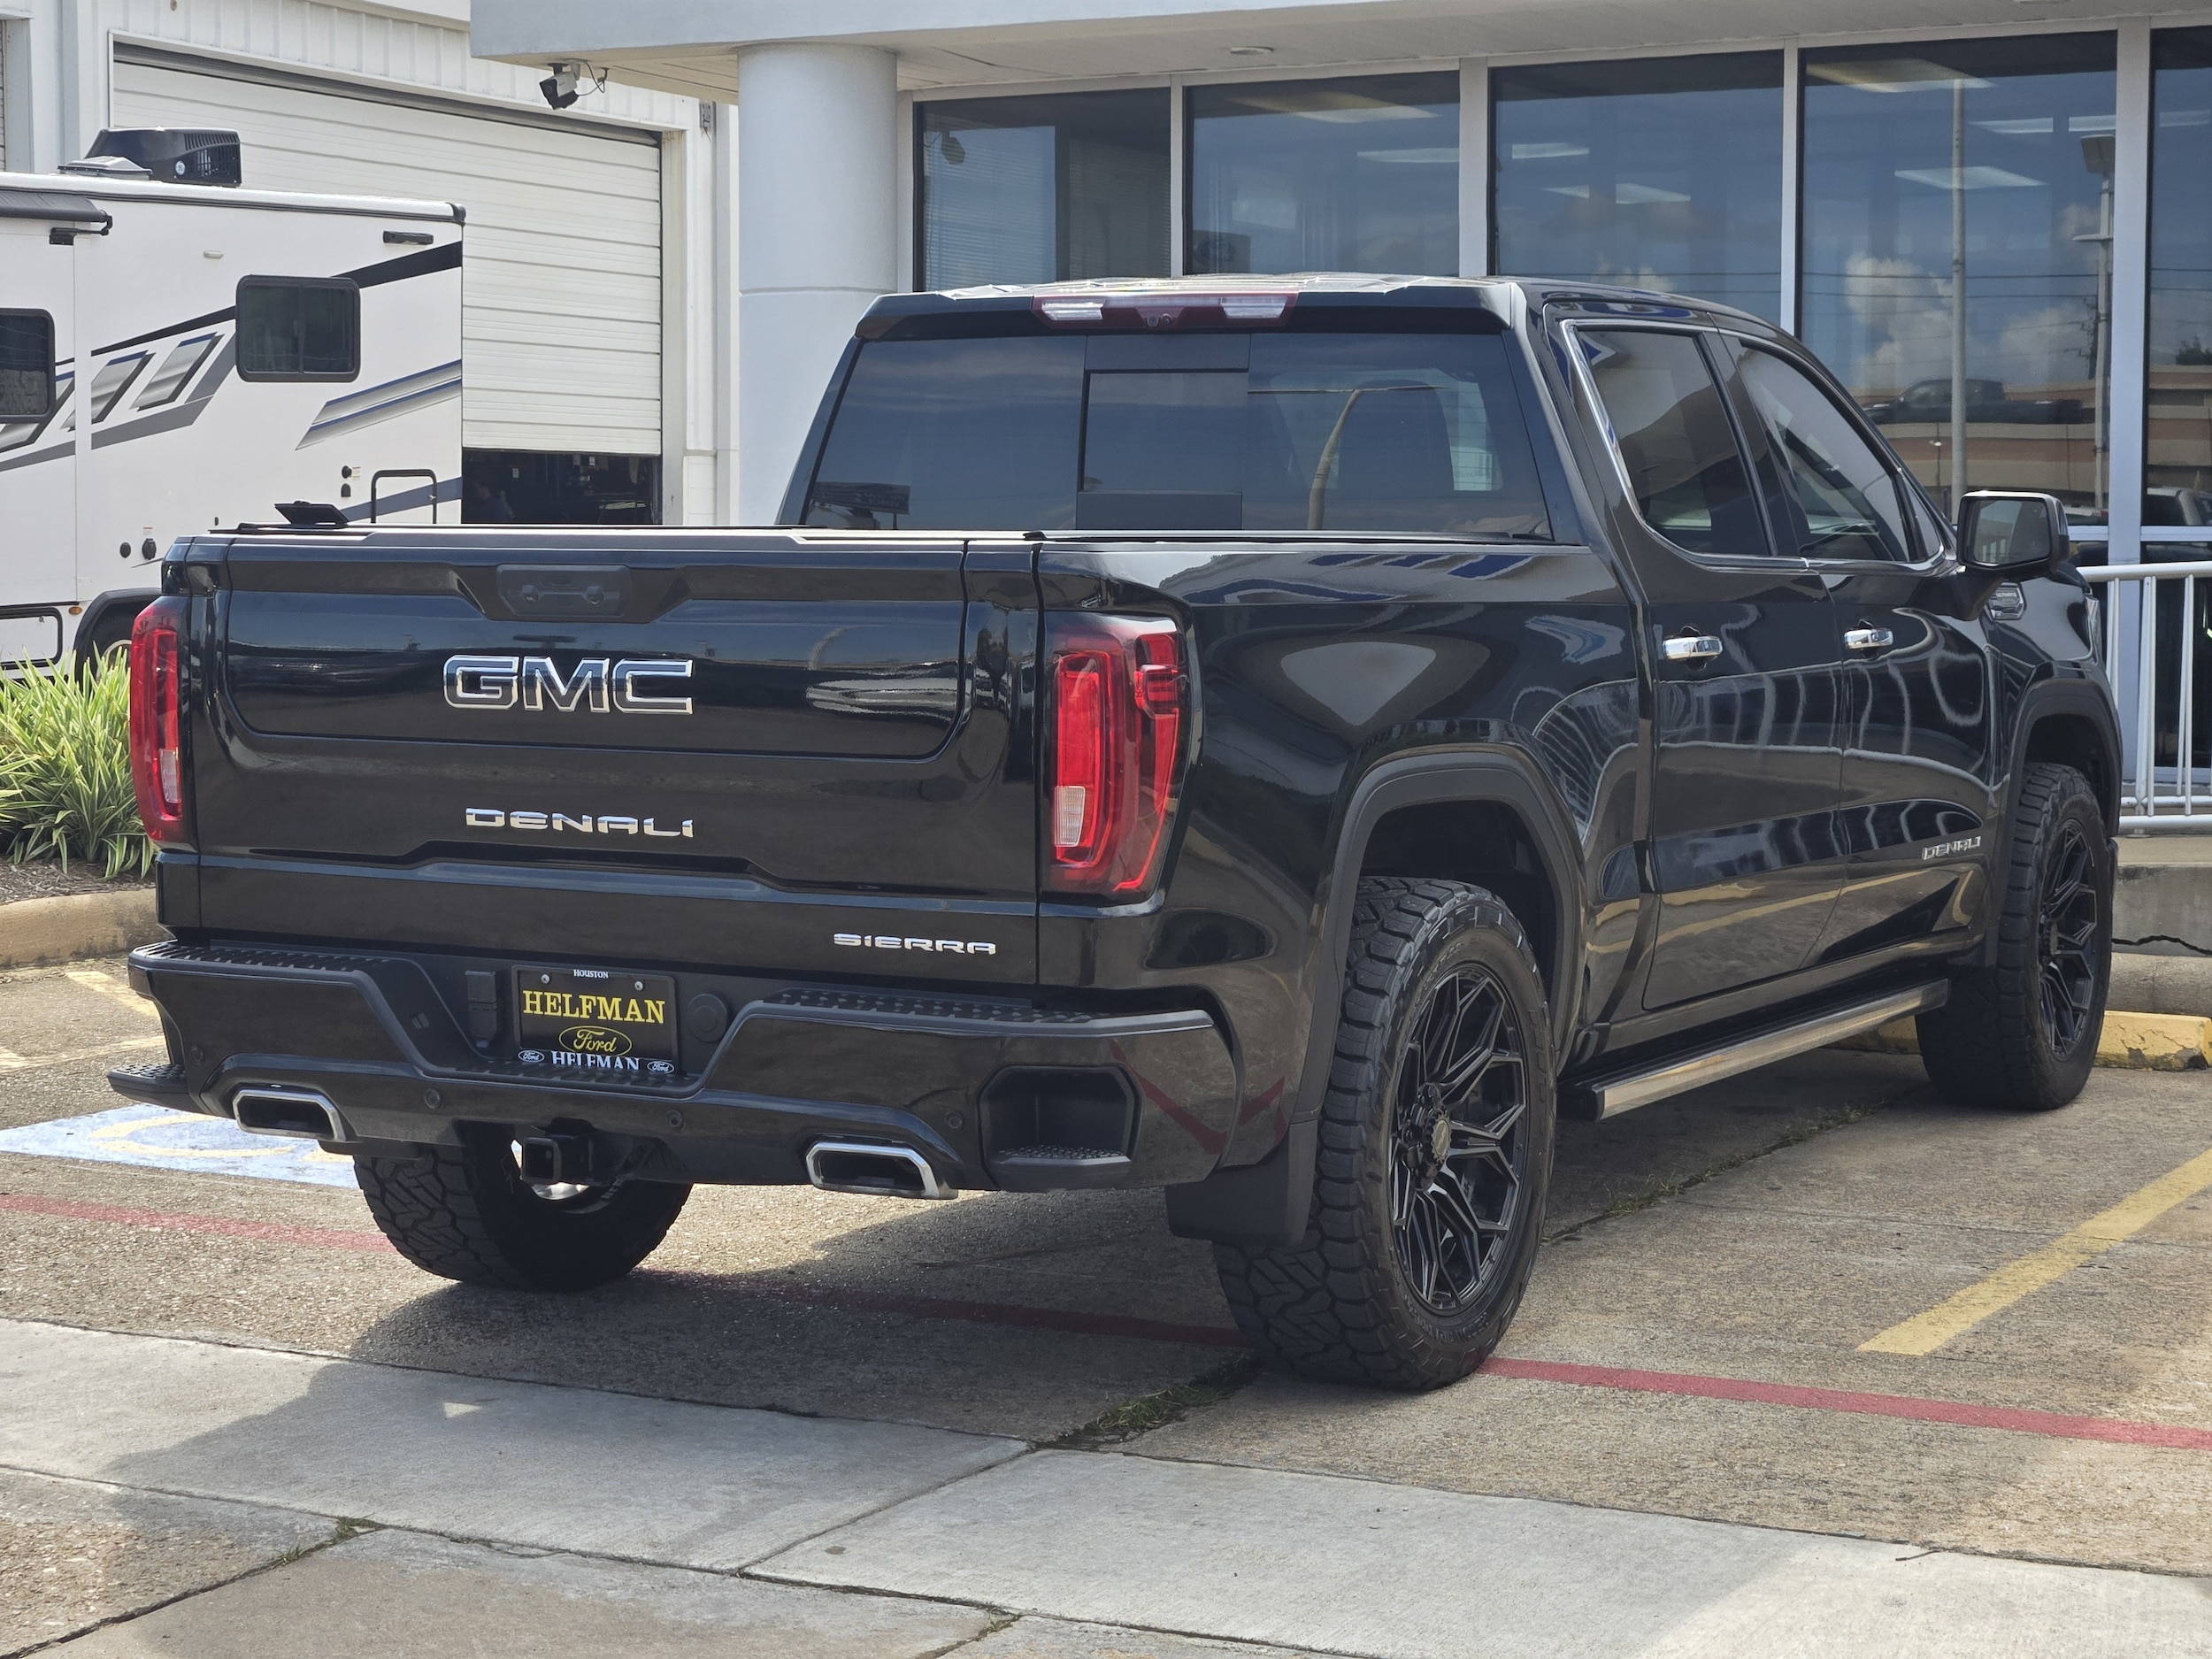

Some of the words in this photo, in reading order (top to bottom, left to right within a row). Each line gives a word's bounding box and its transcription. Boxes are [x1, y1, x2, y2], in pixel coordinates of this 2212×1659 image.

[443, 655, 694, 714] GMC
[465, 808, 694, 838] DENALI
[1921, 836, 1981, 860] DENALI
[833, 933, 996, 955] SIERRA
[573, 969, 609, 979] HOUSTON
[522, 990, 665, 1024] HELFMAN
[573, 1029, 617, 1053] Ford
